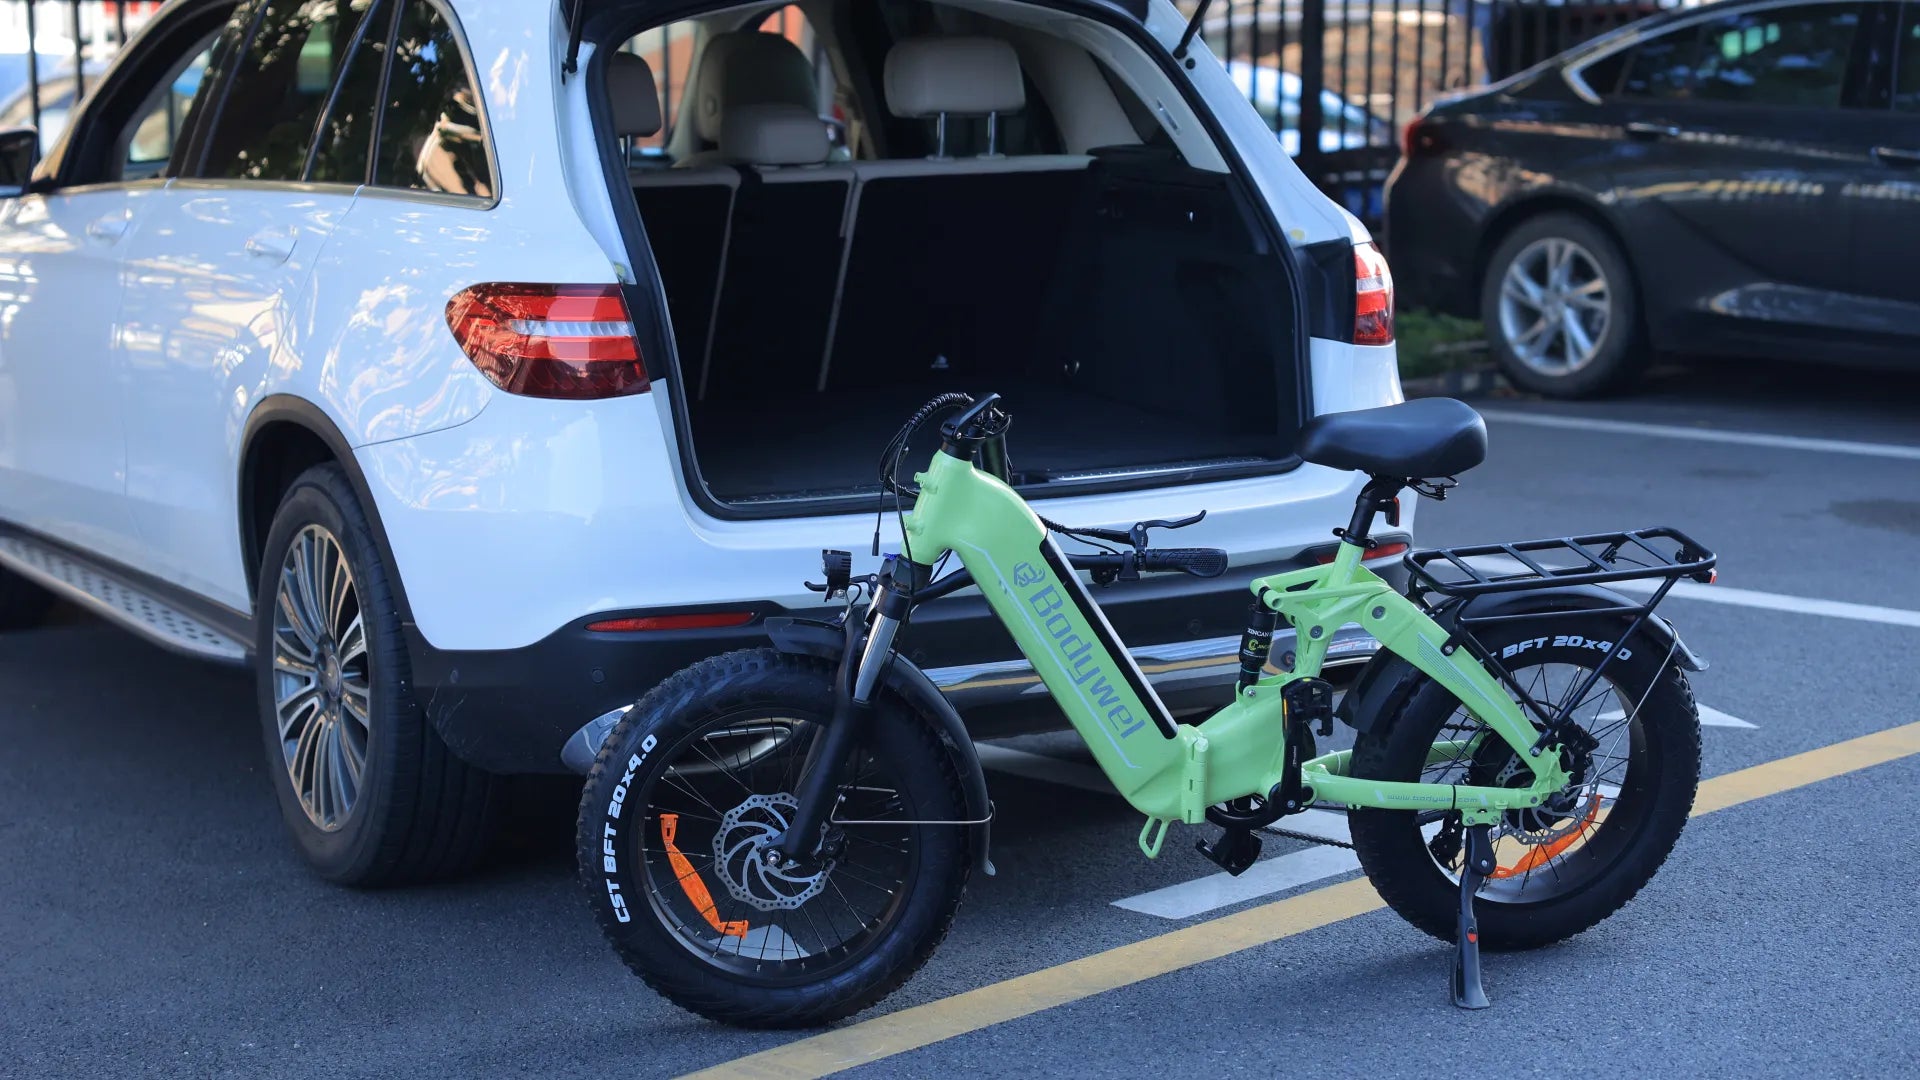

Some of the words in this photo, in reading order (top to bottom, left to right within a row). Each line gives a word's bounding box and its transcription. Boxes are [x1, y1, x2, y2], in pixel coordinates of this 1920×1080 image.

[1028, 583, 1146, 739] Bodywel
[1502, 637, 1548, 659] BFT
[1552, 635, 1633, 661] 20x40
[607, 733, 658, 819] 20x4.0
[603, 822, 617, 873] BFT
[606, 878, 632, 923] CST
